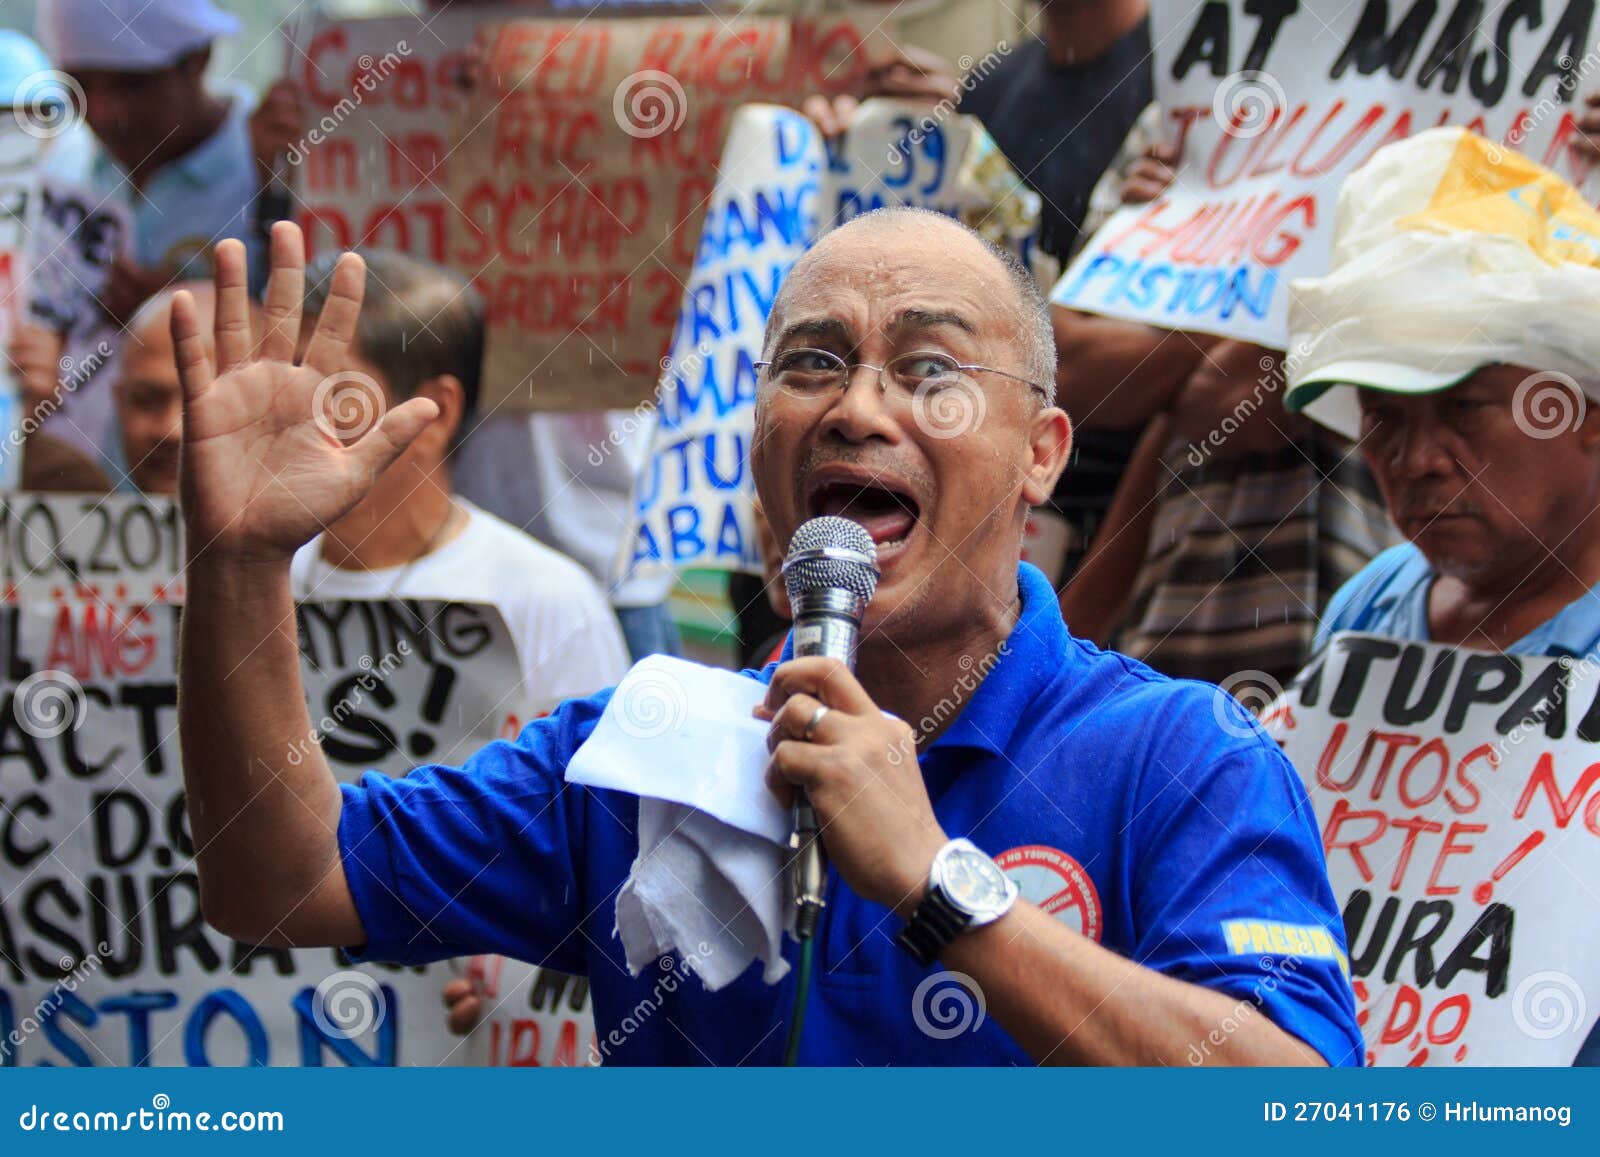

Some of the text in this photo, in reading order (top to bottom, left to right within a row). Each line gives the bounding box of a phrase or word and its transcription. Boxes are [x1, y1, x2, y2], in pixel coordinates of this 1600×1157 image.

[1171, 0, 1298, 82] AT
[884, 117, 946, 196] 39
[452, 173, 649, 270] SCRAP
[1058, 252, 1282, 321] PISTON
[45, 601, 158, 682] ANG
[1317, 721, 1499, 815] UTOS
[1228, 921, 1346, 968] PRESID
